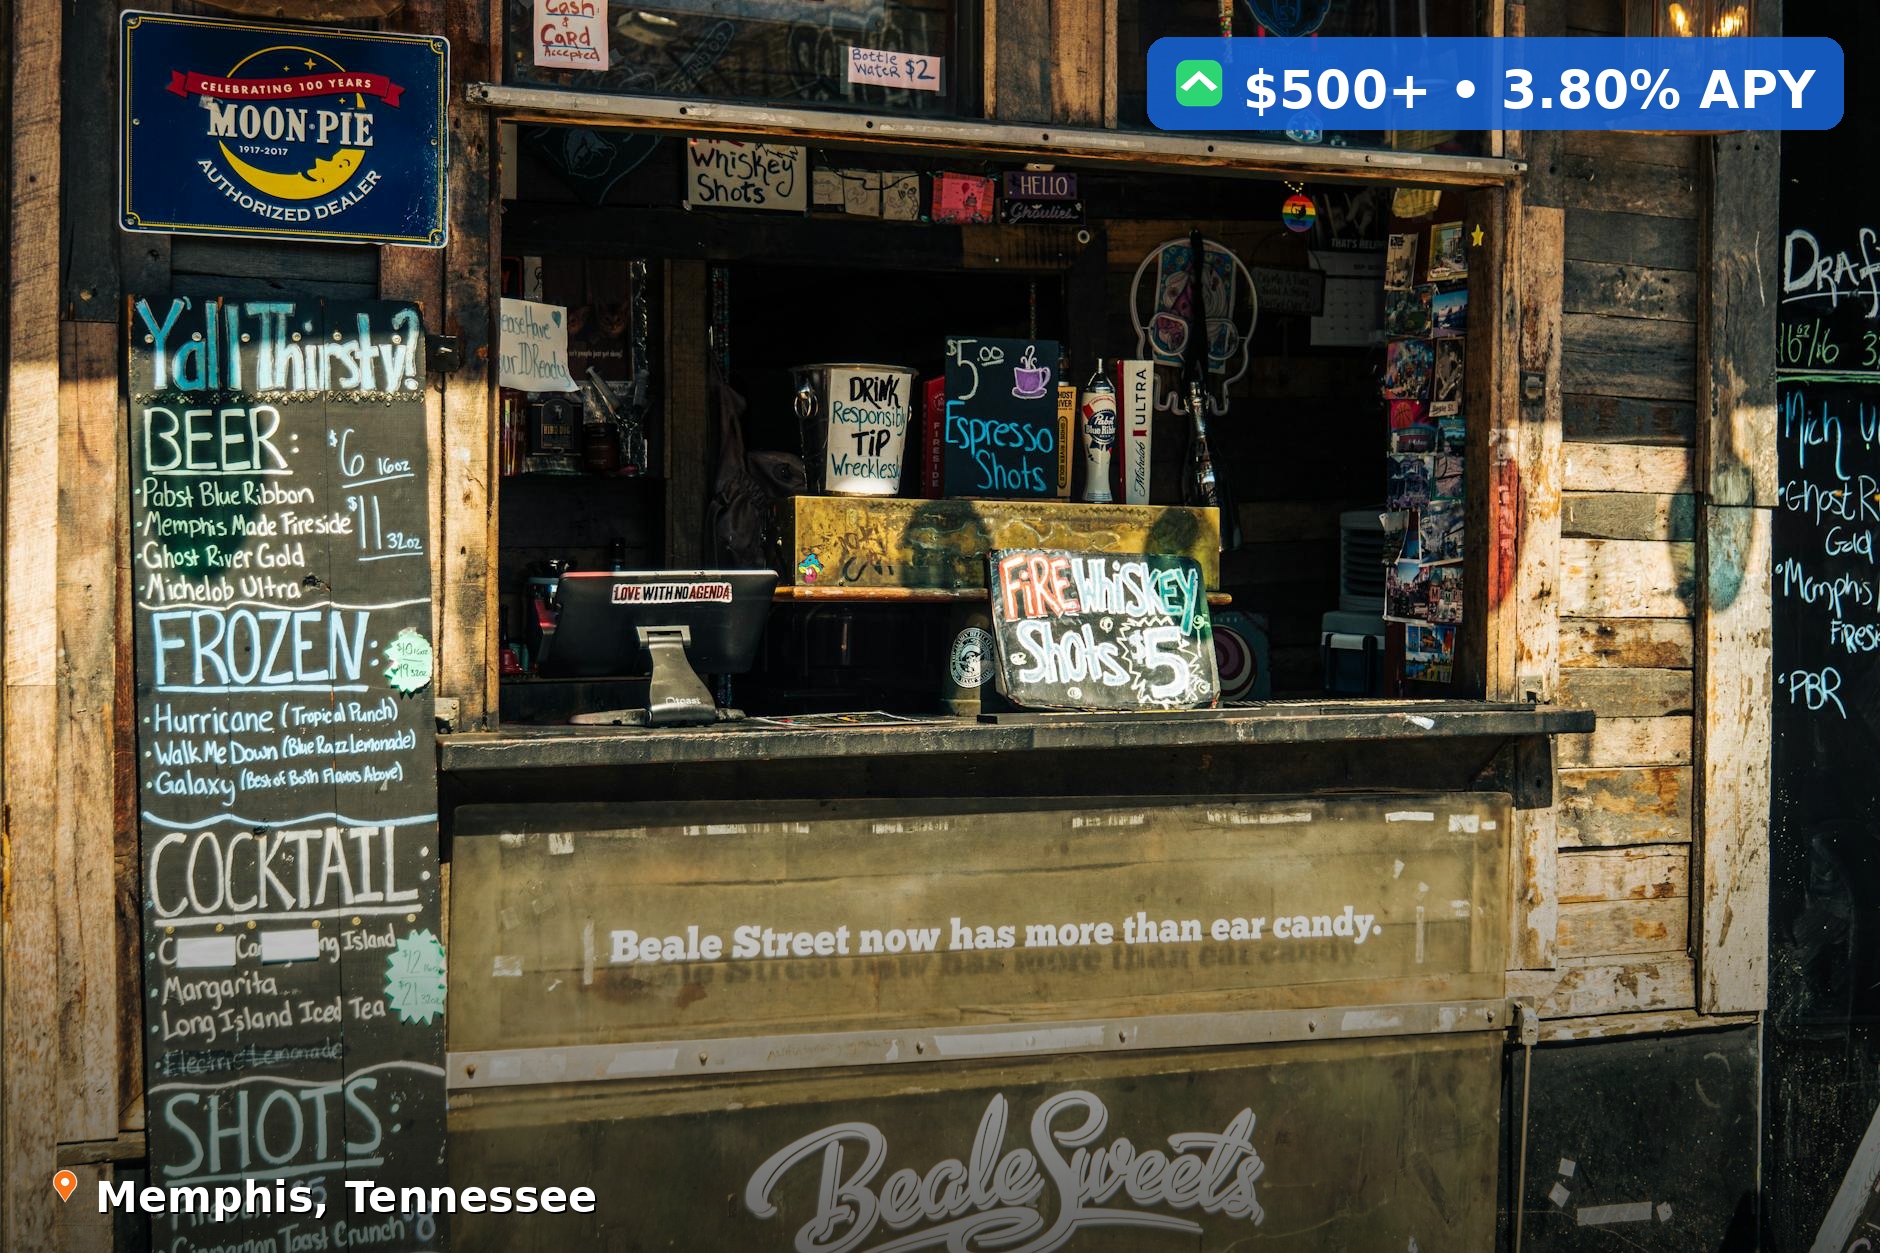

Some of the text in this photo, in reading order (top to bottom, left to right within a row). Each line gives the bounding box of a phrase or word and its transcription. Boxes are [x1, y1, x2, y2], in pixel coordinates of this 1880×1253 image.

[545, 46, 600, 61] Accepted
[851, 48, 897, 66] Bottle
[905, 59, 936, 82] $2
[201, 77, 372, 96] CELEBRATING 100 YEARS
[239, 145, 288, 157] 1917-2017
[690, 146, 794, 197] Whiskey
[197, 159, 382, 222] AUTHORIZED DEALER
[697, 174, 766, 205] Shots
[1020, 175, 1068, 196] HELLO
[135, 296, 420, 392] Y'all Thirsty?
[501, 313, 525, 336] ease
[946, 339, 1005, 401] $5.00
[1058, 399, 1073, 407] IVER
[1135, 368, 1147, 425] ULTRA
[144, 405, 299, 472] BEER:
[945, 400, 1055, 459] Espresso
[1094, 412, 1115, 425] Pabst
[328, 429, 411, 477] $6 16oz
[973, 449, 1048, 493] Shots
[1134, 439, 1146, 498] Michelob
[142, 478, 315, 508] Pabst Blue Ribbon
[1786, 480, 1855, 526] Ghost
[144, 511, 353, 538] Memphis Made Fireside
[347, 495, 422, 550] $11 32oz
[144, 541, 305, 568] Ghost River Gold
[1826, 526, 1874, 565] Gold
[148, 573, 301, 601] Michelob Ultra
[614, 584, 731, 601] LOVE WITH NO AGENDA
[1784, 557, 1873, 619] Memphis
[152, 609, 380, 685] FROZEN:
[1016, 620, 1131, 688] Shots
[1128, 625, 1191, 700] $5
[674, 695, 702, 705] toast
[1790, 667, 1846, 719] PBR
[153, 697, 399, 734] Hurricane (Tropical Punch)
[153, 729, 416, 767] Walk Me Down (Blue Razz Lemonade)
[155, 773, 236, 806] Galaxy
[289, 768, 319, 786] Both
[363, 761, 404, 783] Above)
[151, 826, 431, 918] COCKTAIL:
[342, 923, 397, 951] Island
[610, 905, 1382, 964] Beale Street now has more than ear candy.
[162, 971, 278, 1009] Margarita
[162, 997, 386, 1043] Long Island Iced Tea
[163, 1078, 401, 1178] SHOTS:
[745, 1090, 1266, 1253] Beale Sweets
[277, 1223, 329, 1253] Toast
[333, 1215, 406, 1248] Crunch
